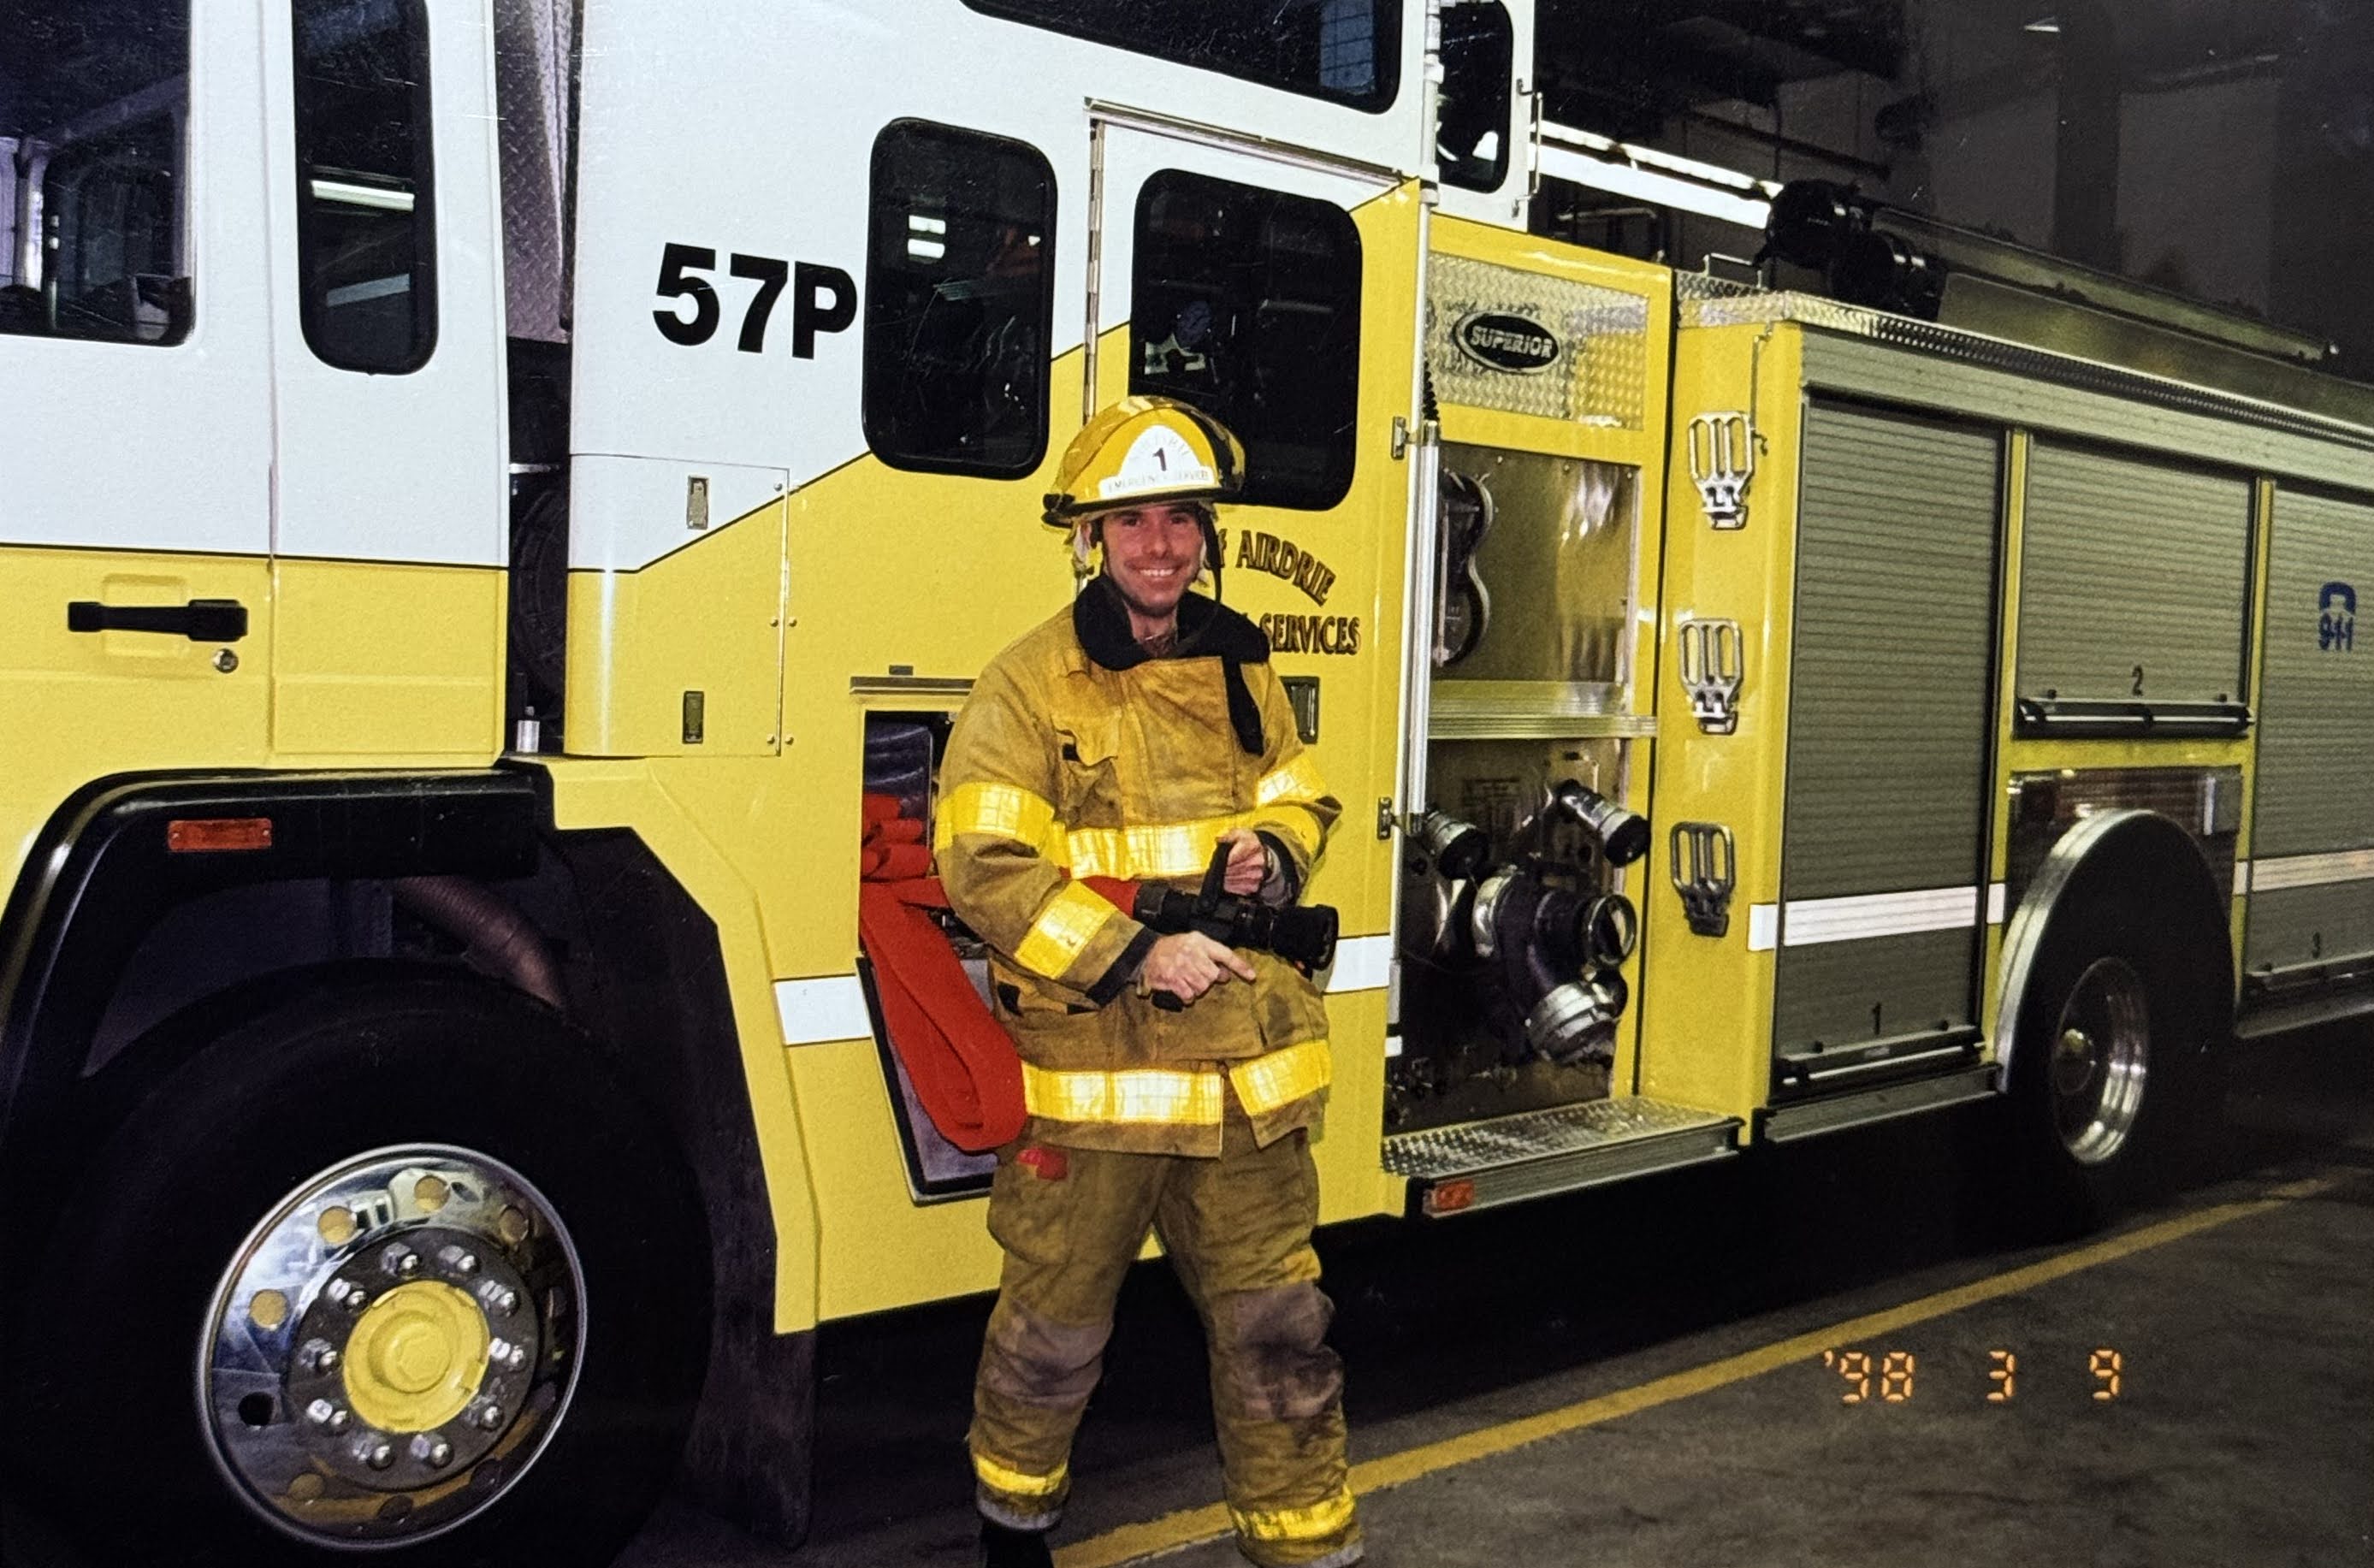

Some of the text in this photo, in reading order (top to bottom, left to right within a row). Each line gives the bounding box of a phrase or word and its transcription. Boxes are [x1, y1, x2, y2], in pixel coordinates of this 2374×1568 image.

[652, 242, 857, 360] 57P
[1469, 325, 1553, 358] SUPERIOR
[1151, 447, 1167, 472] 1
[1235, 530, 1336, 606] AIRDRIE
[1259, 612, 1361, 655] SERVICES
[2131, 665, 2144, 697] 2
[2312, 932, 2322, 960] 3
[1872, 1002, 1882, 1036] 1
